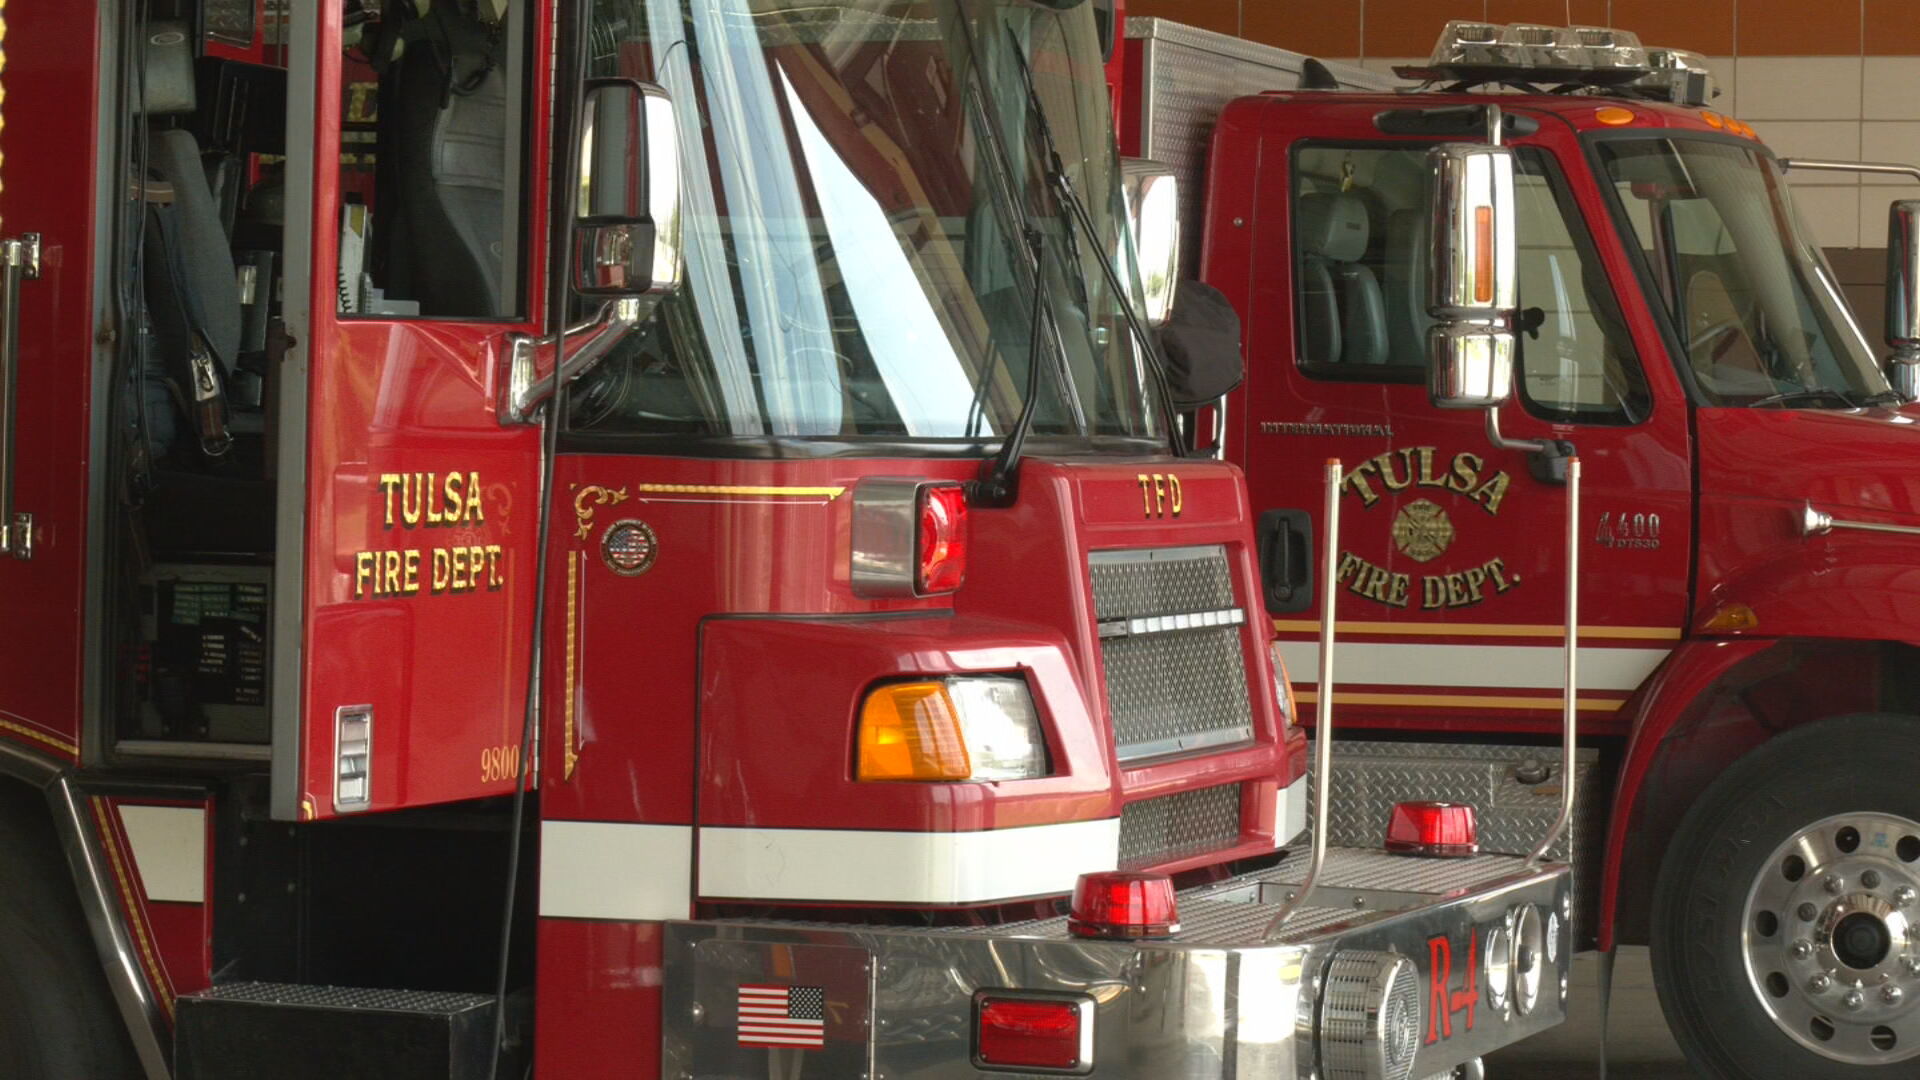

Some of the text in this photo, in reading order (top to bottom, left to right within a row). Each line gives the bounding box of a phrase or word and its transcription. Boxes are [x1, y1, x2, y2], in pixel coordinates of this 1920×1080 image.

[379, 471, 485, 527] TULSA
[1138, 473, 1182, 516] TFD
[1340, 447, 1511, 515] TULSA
[355, 545, 504, 597] FIRE DEPT.
[1336, 552, 1521, 609] FIRE DEPT.
[481, 744, 529, 783] 9800
[1424, 927, 1480, 1046] R-4
